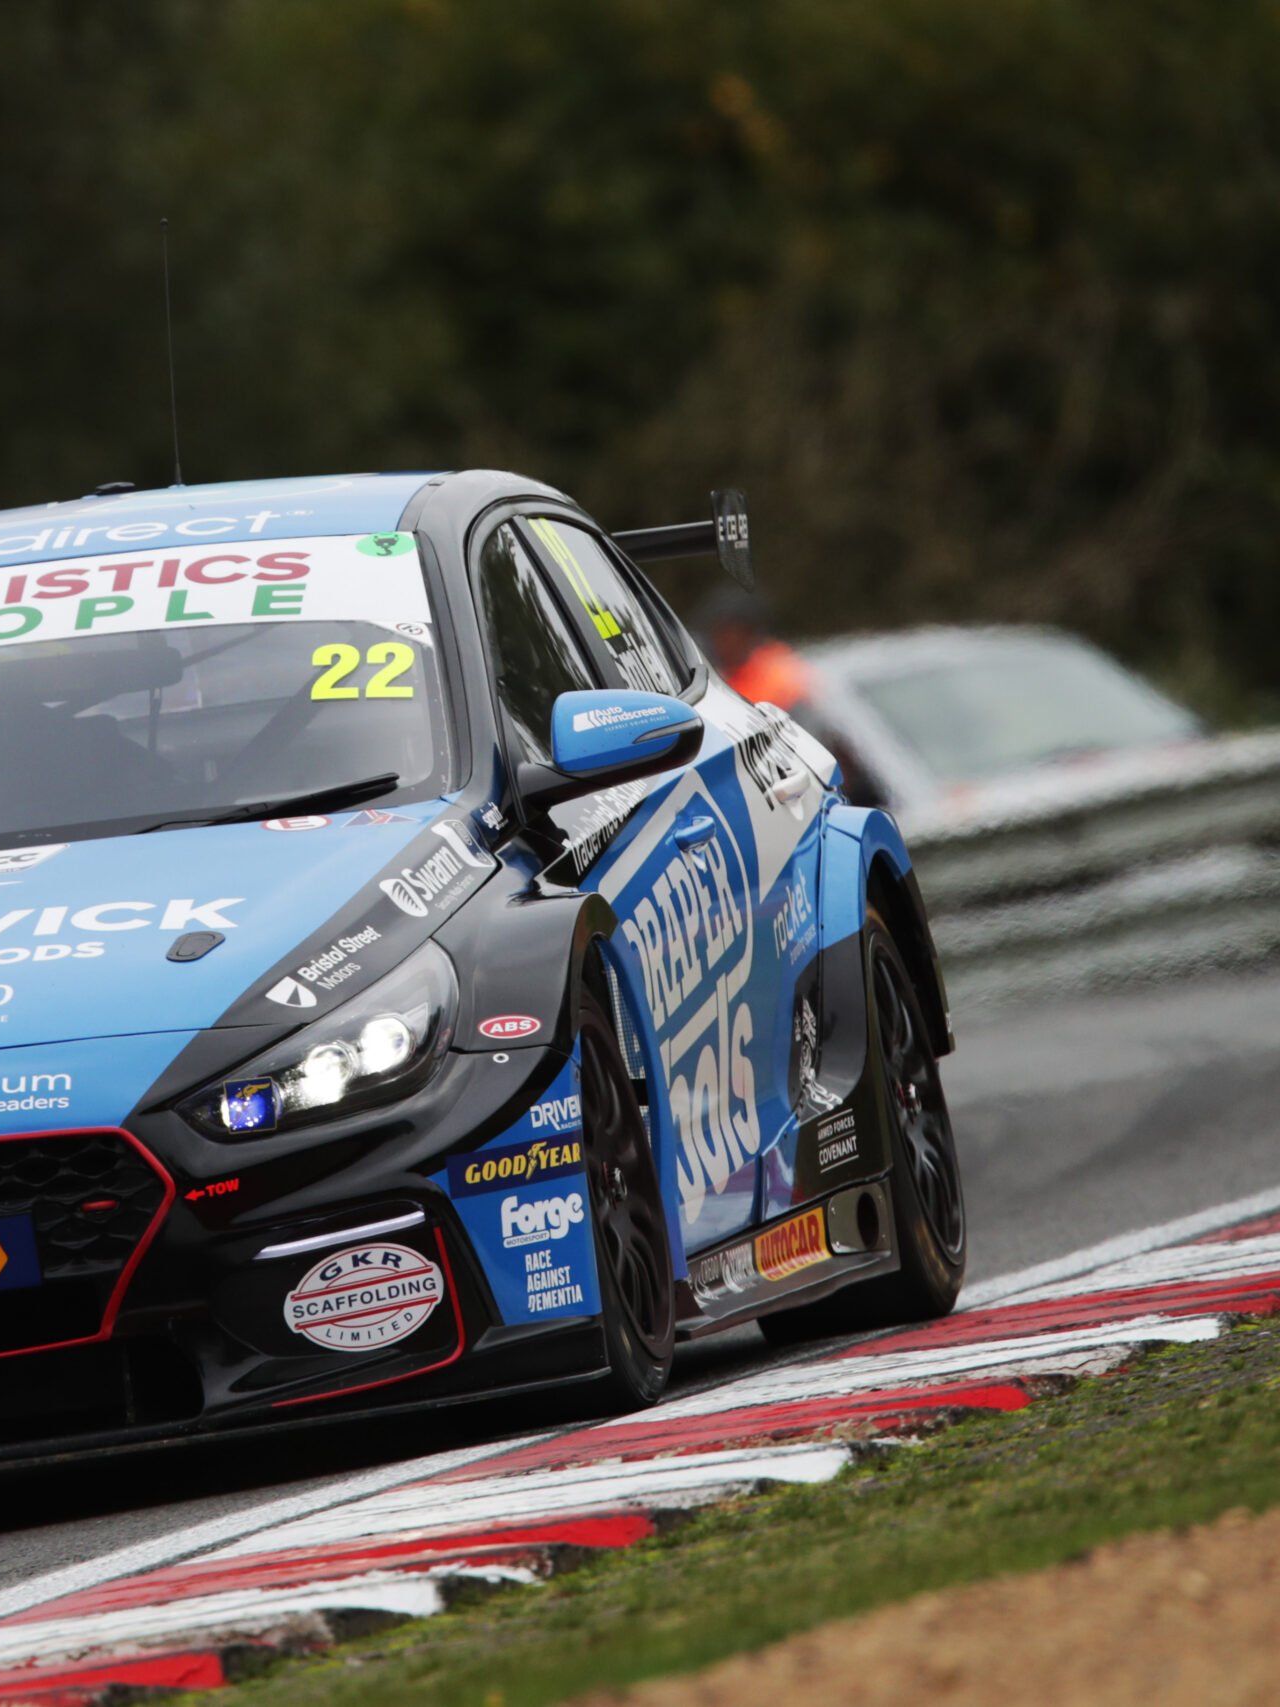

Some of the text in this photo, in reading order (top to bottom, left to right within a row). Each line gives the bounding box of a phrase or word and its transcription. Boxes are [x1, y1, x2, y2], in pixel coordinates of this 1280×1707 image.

[310, 641, 415, 701] 22
[595, 706, 623, 717] Auto
[597, 706, 667, 726] Windscreens
[401, 846, 463, 901] Swann
[773, 868, 812, 959] rocket
[297, 925, 382, 982] Bristol Street
[317, 961, 362, 991] Motors
[489, 1019, 532, 1034] ABS
[834, 1115, 856, 1134] FORCES
[819, 1135, 858, 1166] COVENANT
[206, 1179, 240, 1197] TOW
[500, 1192, 585, 1240] forge
[319, 1251, 403, 1283] GKR
[525, 1249, 552, 1273] RACE
[527, 1266, 571, 1293] AGAINST
[292, 1277, 437, 1319] SCAFFOLDING
[528, 1284, 584, 1313] DEMENTIA
[325, 1311, 414, 1342] LIMITED
